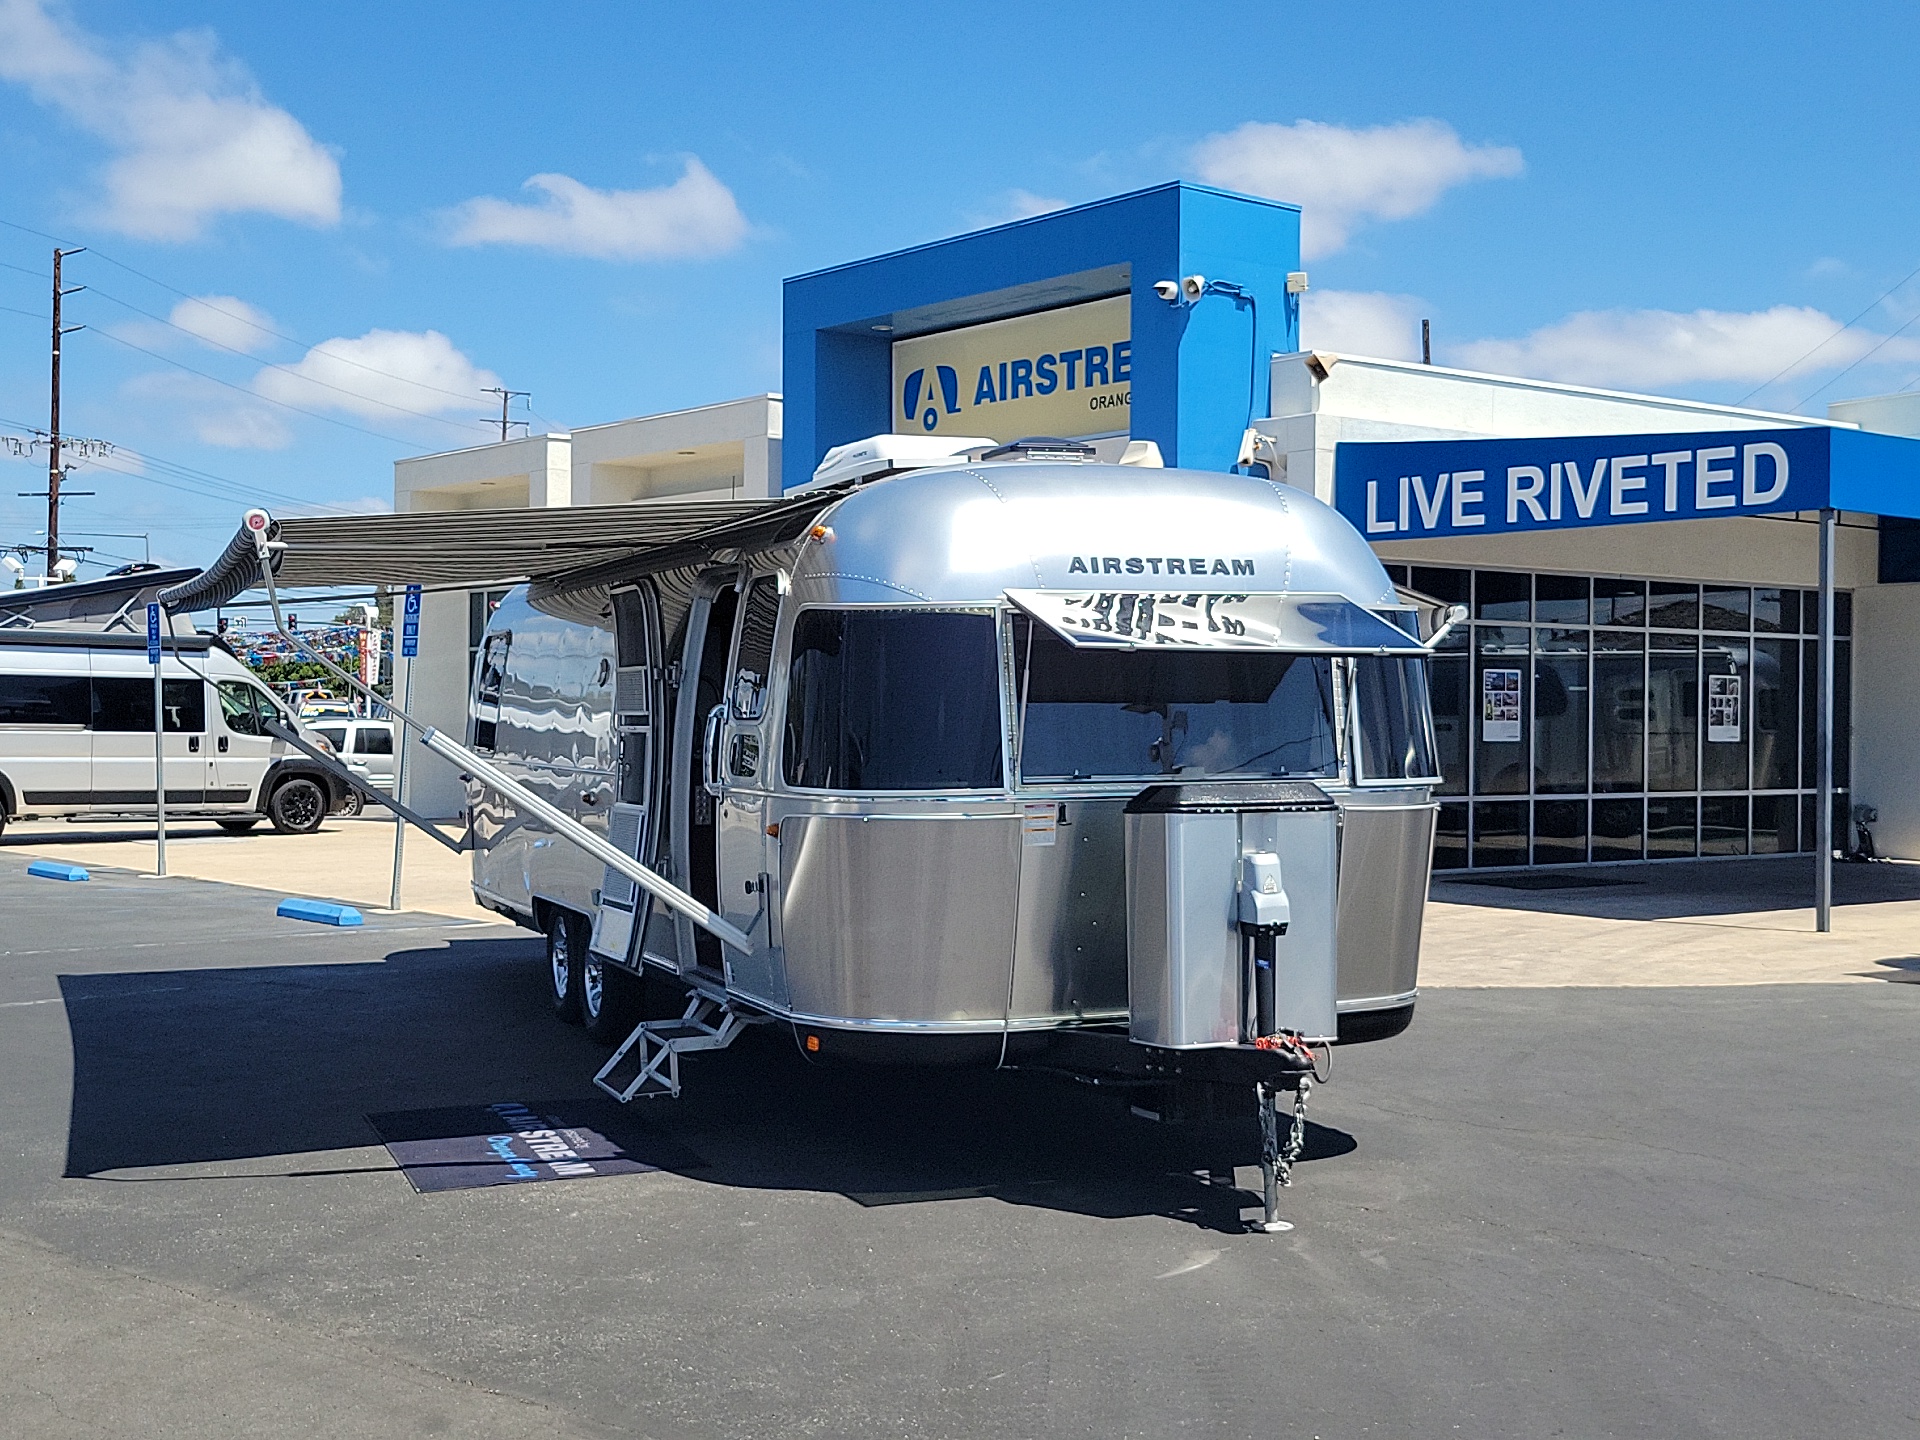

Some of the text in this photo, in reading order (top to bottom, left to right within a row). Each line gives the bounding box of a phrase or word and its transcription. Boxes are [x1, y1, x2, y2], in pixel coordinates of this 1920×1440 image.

[973, 341, 1131, 406] AIRSTRE
[1367, 442, 1789, 533] LIVE RIVETED
[1068, 556, 1255, 576] AIRSTREAM
